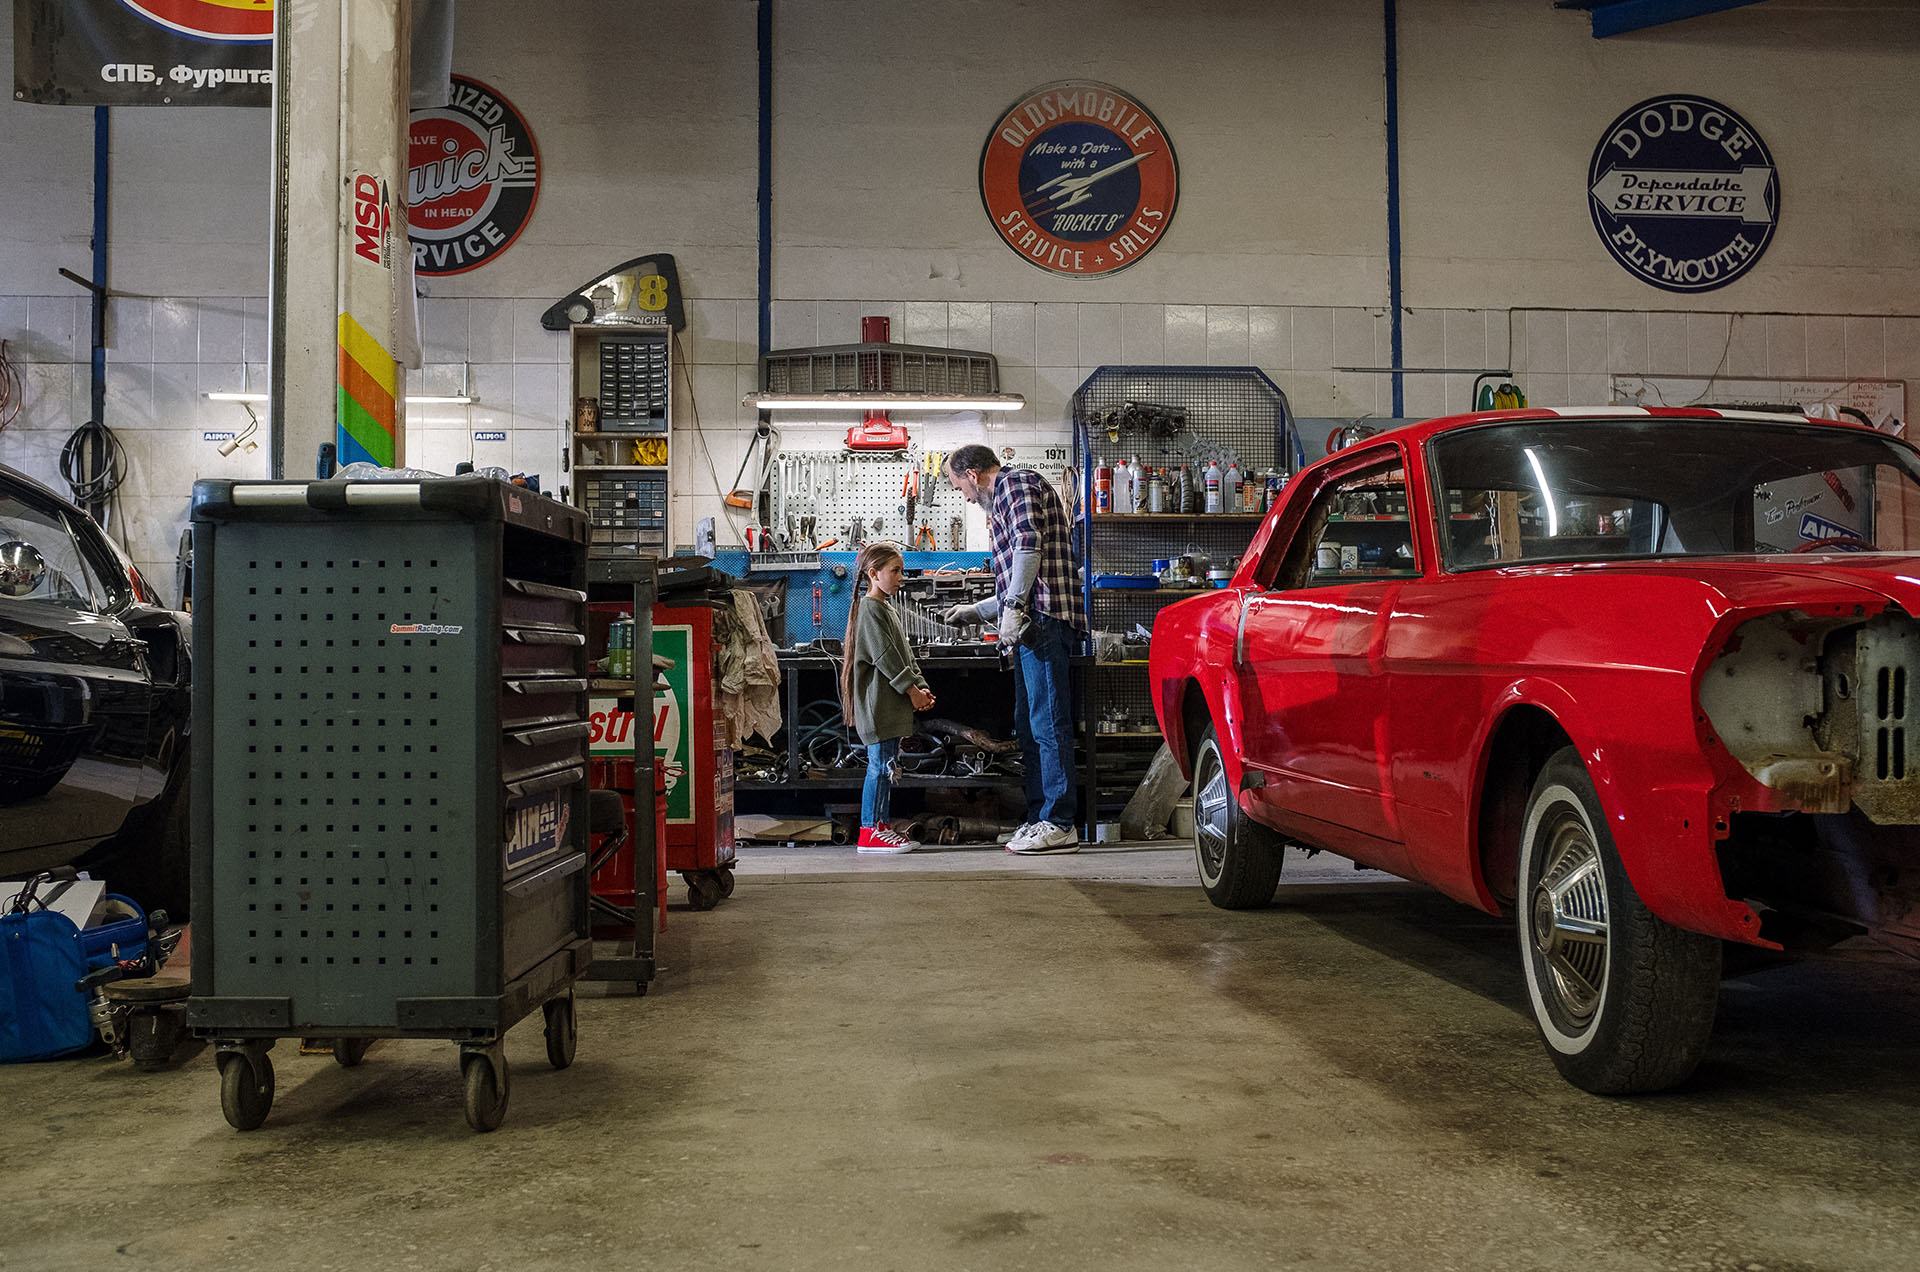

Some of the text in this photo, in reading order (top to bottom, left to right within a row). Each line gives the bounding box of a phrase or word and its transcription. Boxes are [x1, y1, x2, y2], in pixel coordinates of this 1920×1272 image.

[101, 64, 273, 88] СПБ, Фуршта
[448, 83, 504, 125] RIZED
[1001, 91, 1155, 148] OLDSMOBILE
[1029, 142, 1066, 157] Make
[1069, 145, 1077, 154] a
[1611, 104, 1753, 161] DODGE
[408, 124, 523, 207] uick
[1061, 157, 1097, 169] with a
[1621, 174, 1743, 192] Dependable
[355, 174, 380, 265] MSD
[425, 208, 474, 217] IN HEAD
[1614, 193, 1746, 213] SERVICE
[412, 220, 506, 267] RVICE
[1000, 209, 1084, 270] SERVICE
[1109, 206, 1164, 262] SALES
[1612, 224, 1755, 282] PLYMOUTH
[1045, 449, 1067, 460] 1971
[589, 704, 669, 743] strl
